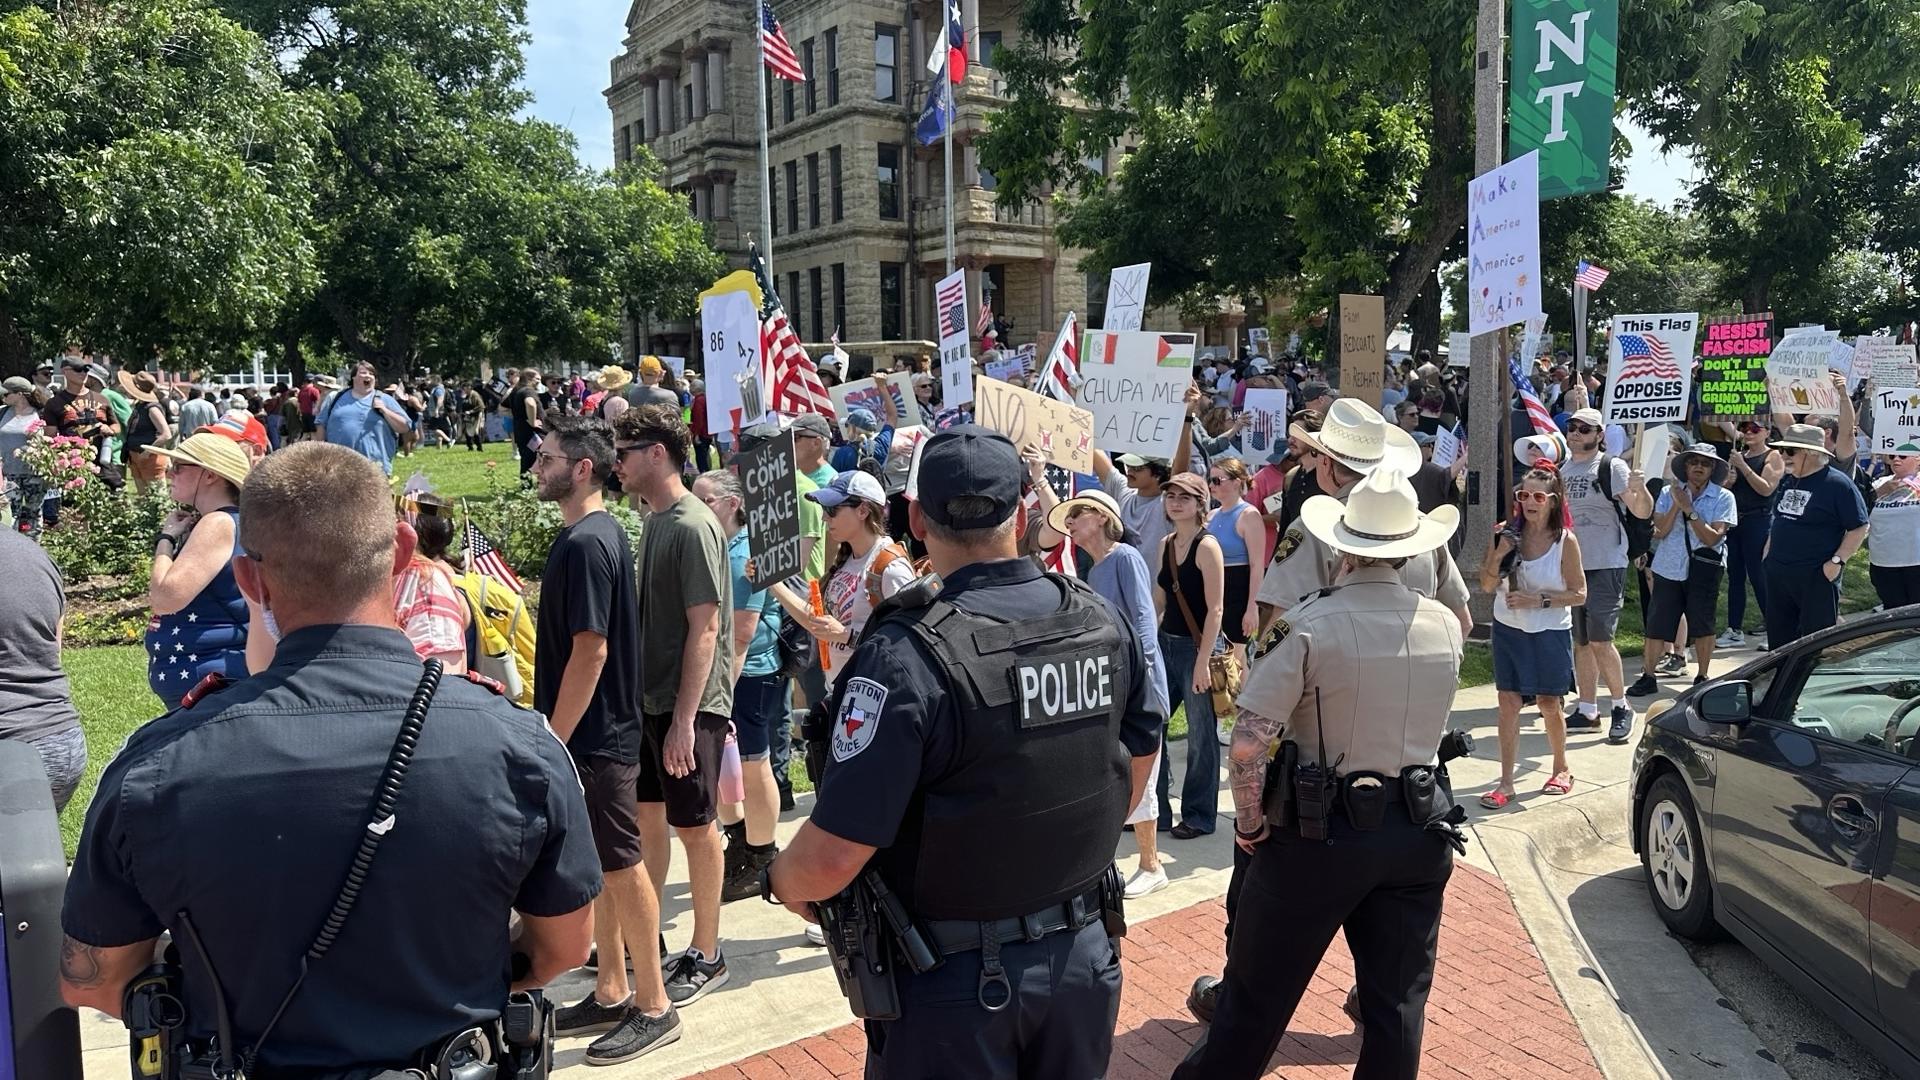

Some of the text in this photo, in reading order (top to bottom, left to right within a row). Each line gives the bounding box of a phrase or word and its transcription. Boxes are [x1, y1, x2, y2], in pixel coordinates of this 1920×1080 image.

[1471, 214, 1521, 246] America
[1471, 253, 1525, 283] America
[1621, 318, 1692, 332] This Flag
[1709, 322, 1768, 340] RESIST
[710, 331, 724, 352] 86
[1703, 338, 1771, 356] FASCISM
[738, 341, 755, 369] 47
[951, 346, 959, 363] ARE
[959, 343, 967, 359] NOT
[1704, 357, 1768, 370] DON'T LET
[1723, 370, 1749, 381] THE
[1083, 377, 1184, 404] CHUPA ME
[1613, 381, 1683, 399] OPPOSES
[1703, 381, 1766, 392] BASTARDS
[1702, 392, 1768, 404] GRIND YOU
[1878, 391, 1908, 414] Tiny
[1610, 405, 1681, 420] FASCISM
[1715, 403, 1756, 415] DOWN!
[1126, 411, 1171, 443] ICE
[1881, 435, 1895, 449] is
[755, 444, 774, 466] WE
[745, 451, 789, 494] COME
[762, 482, 776, 501] IN
[749, 490, 797, 539] PEACE-
[762, 527, 785, 549] FUL
[752, 534, 800, 584] PROTEST
[846, 681, 882, 702] DENTON
[1019, 655, 1112, 719] POLICE
[834, 733, 860, 753] POLICE
